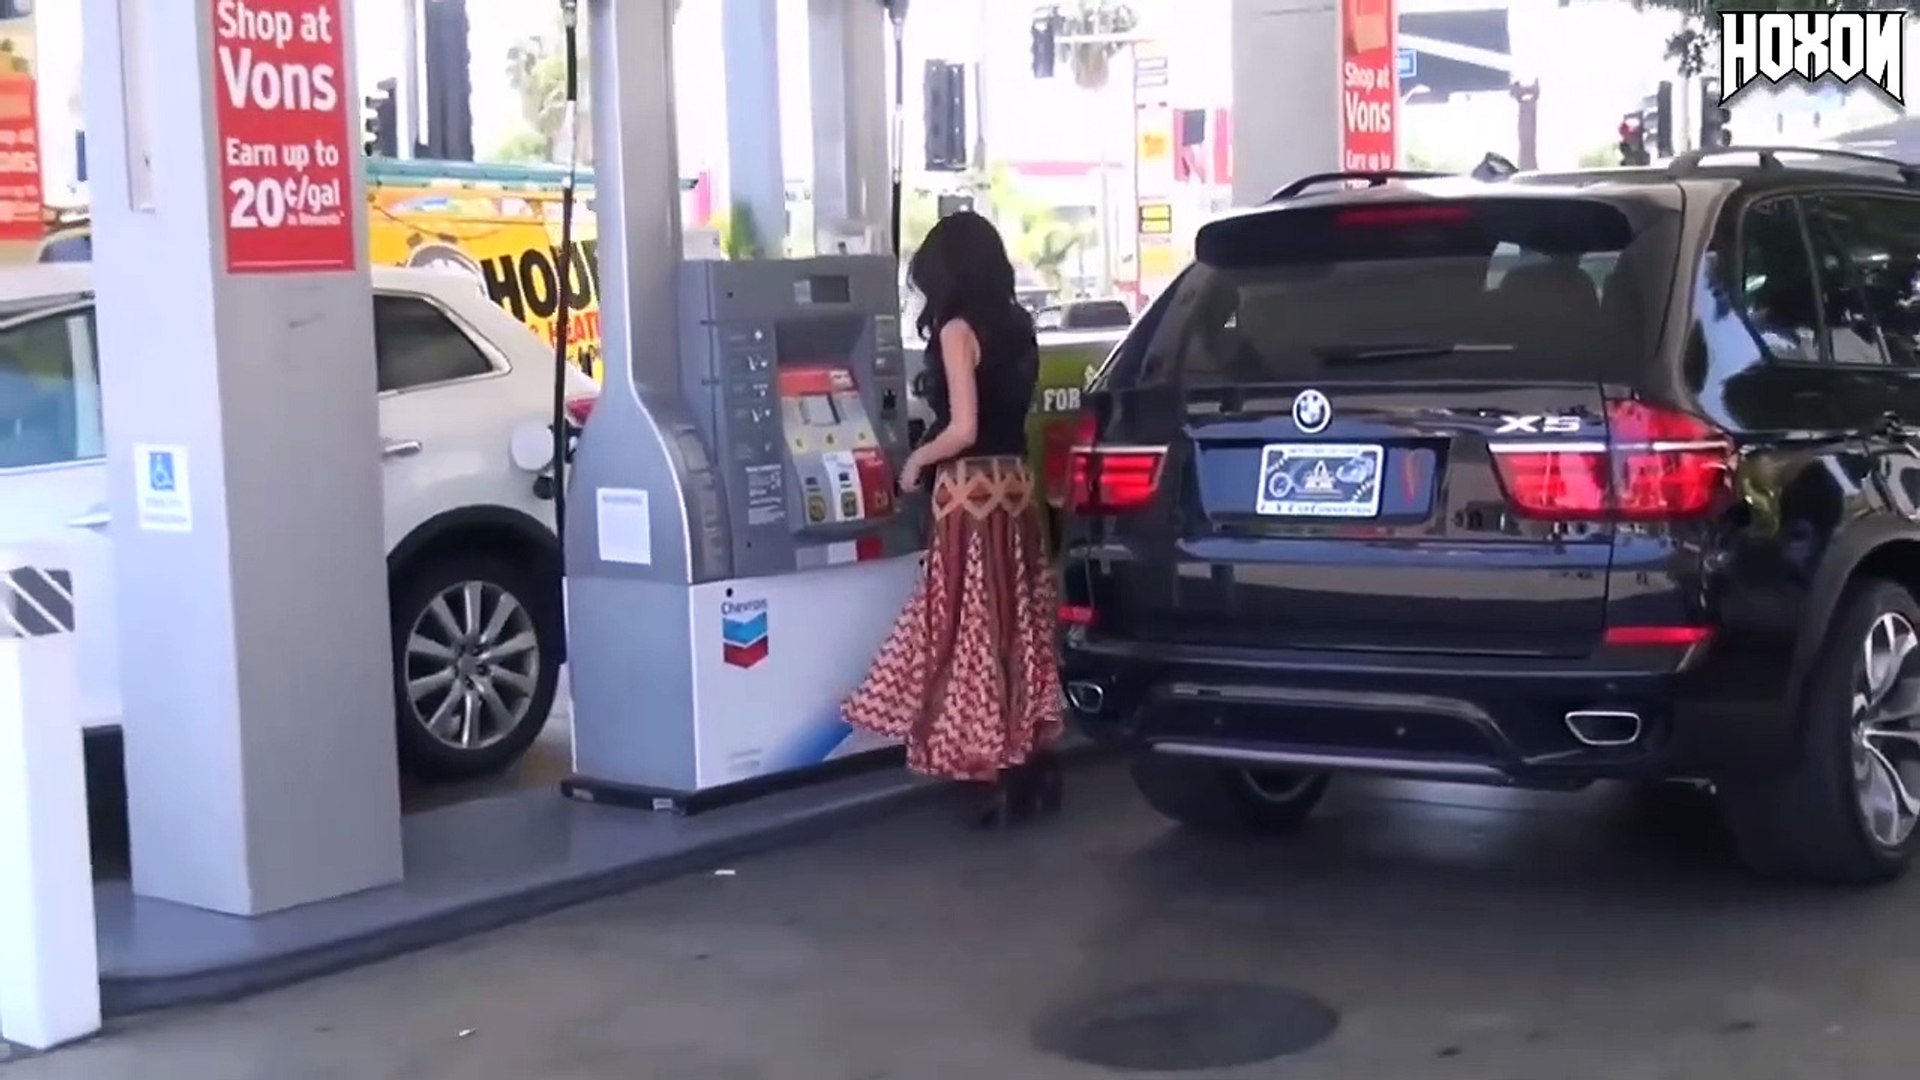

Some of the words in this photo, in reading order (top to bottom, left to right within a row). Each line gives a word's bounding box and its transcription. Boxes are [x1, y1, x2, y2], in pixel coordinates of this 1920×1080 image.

[217, 0, 293, 50] Shop
[300, 5, 333, 44] at
[218, 45, 338, 112] Vons
[1345, 60, 1375, 95] Shop
[1376, 65, 1391, 90] at
[1345, 90, 1392, 133] Vons
[226, 137, 278, 166] Earn
[282, 144, 310, 172] up
[315, 139, 340, 167] to
[1043, 387, 1081, 411] FOR
[1495, 415, 1581, 433] X5
[721, 599, 768, 615] Chevron
